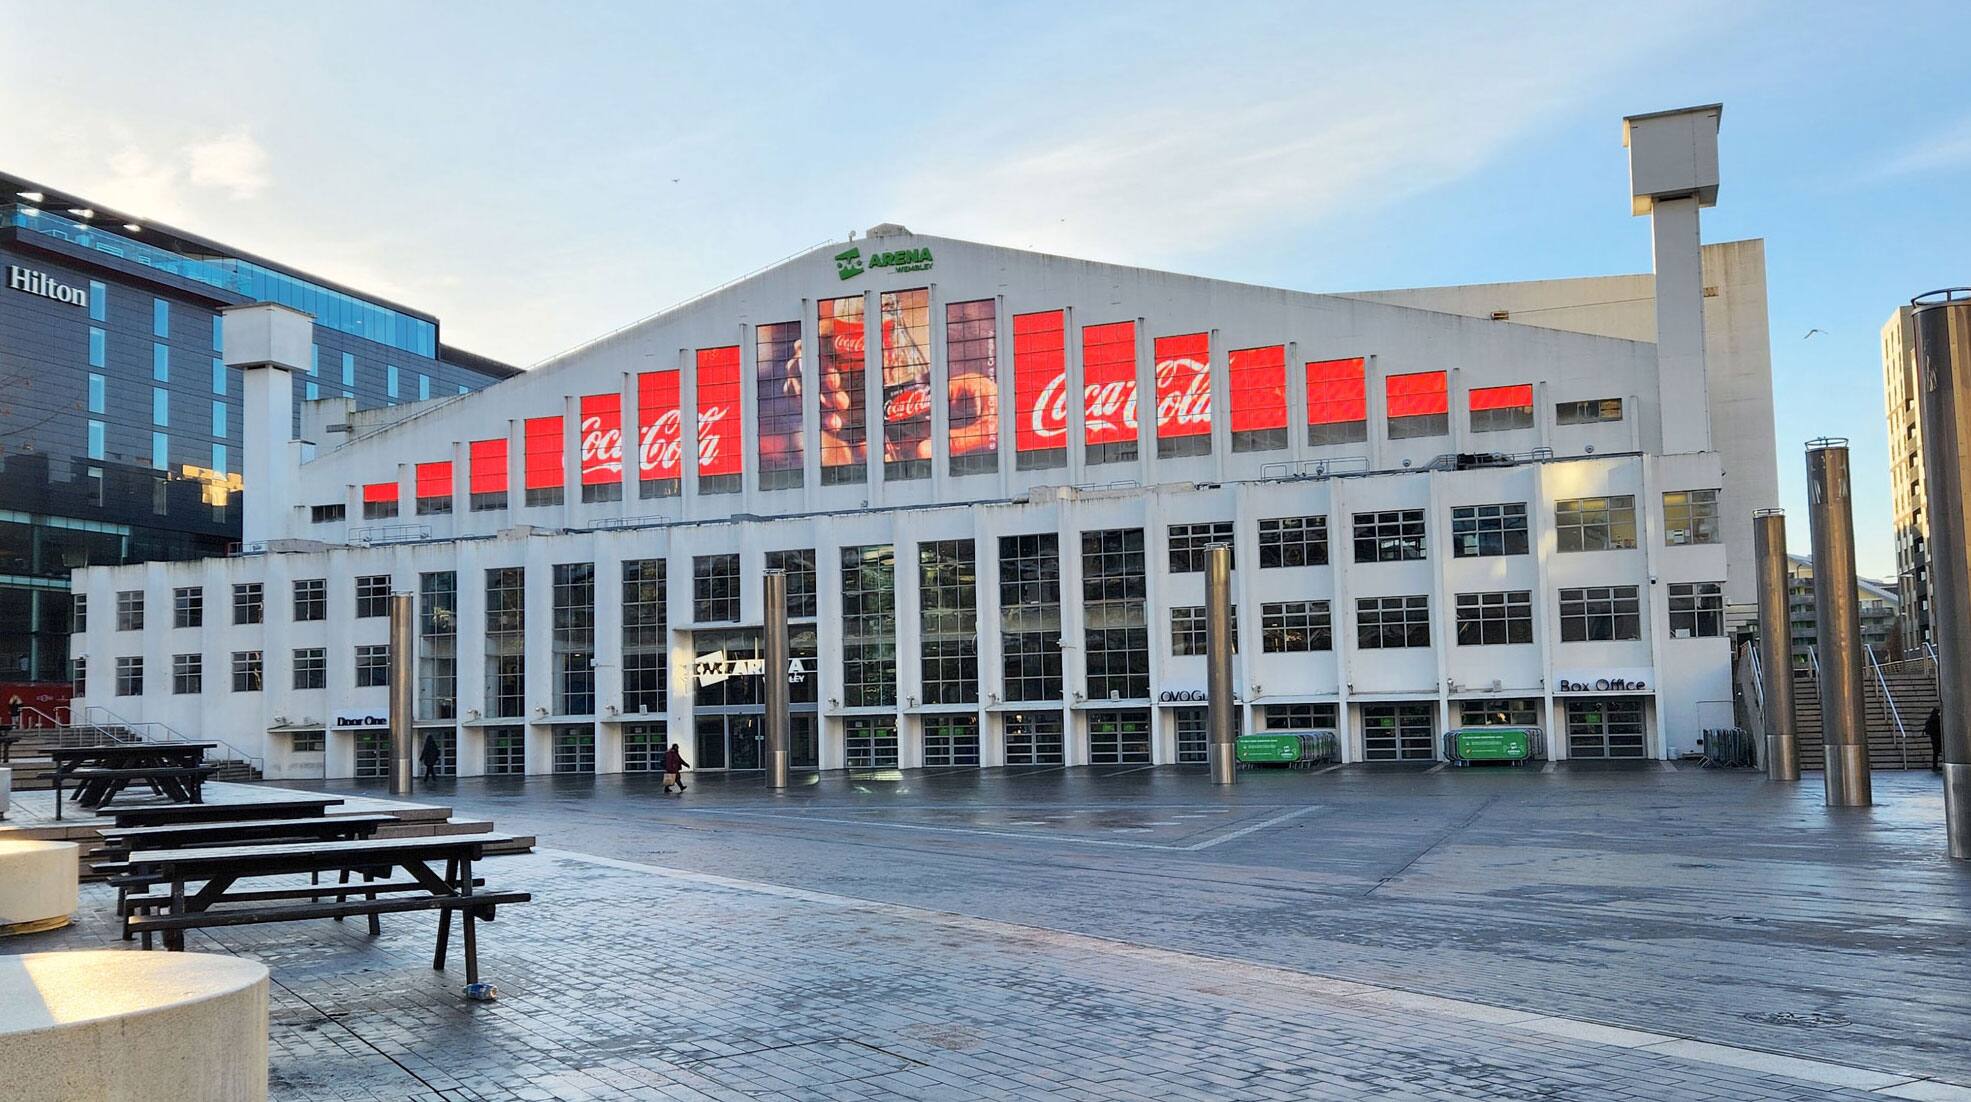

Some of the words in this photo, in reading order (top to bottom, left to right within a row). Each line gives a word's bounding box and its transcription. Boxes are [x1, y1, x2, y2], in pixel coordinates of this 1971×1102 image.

[868, 247, 933, 269] ARENA
[896, 263, 934, 273] WEMBLEY
[10, 265, 87, 307] Hilton
[1560, 679, 1590, 691] Box
[1596, 678, 1645, 691] Office
[1161, 691, 1190, 702] OVO
[337, 716, 363, 726] Door
[364, 715, 387, 726] One
